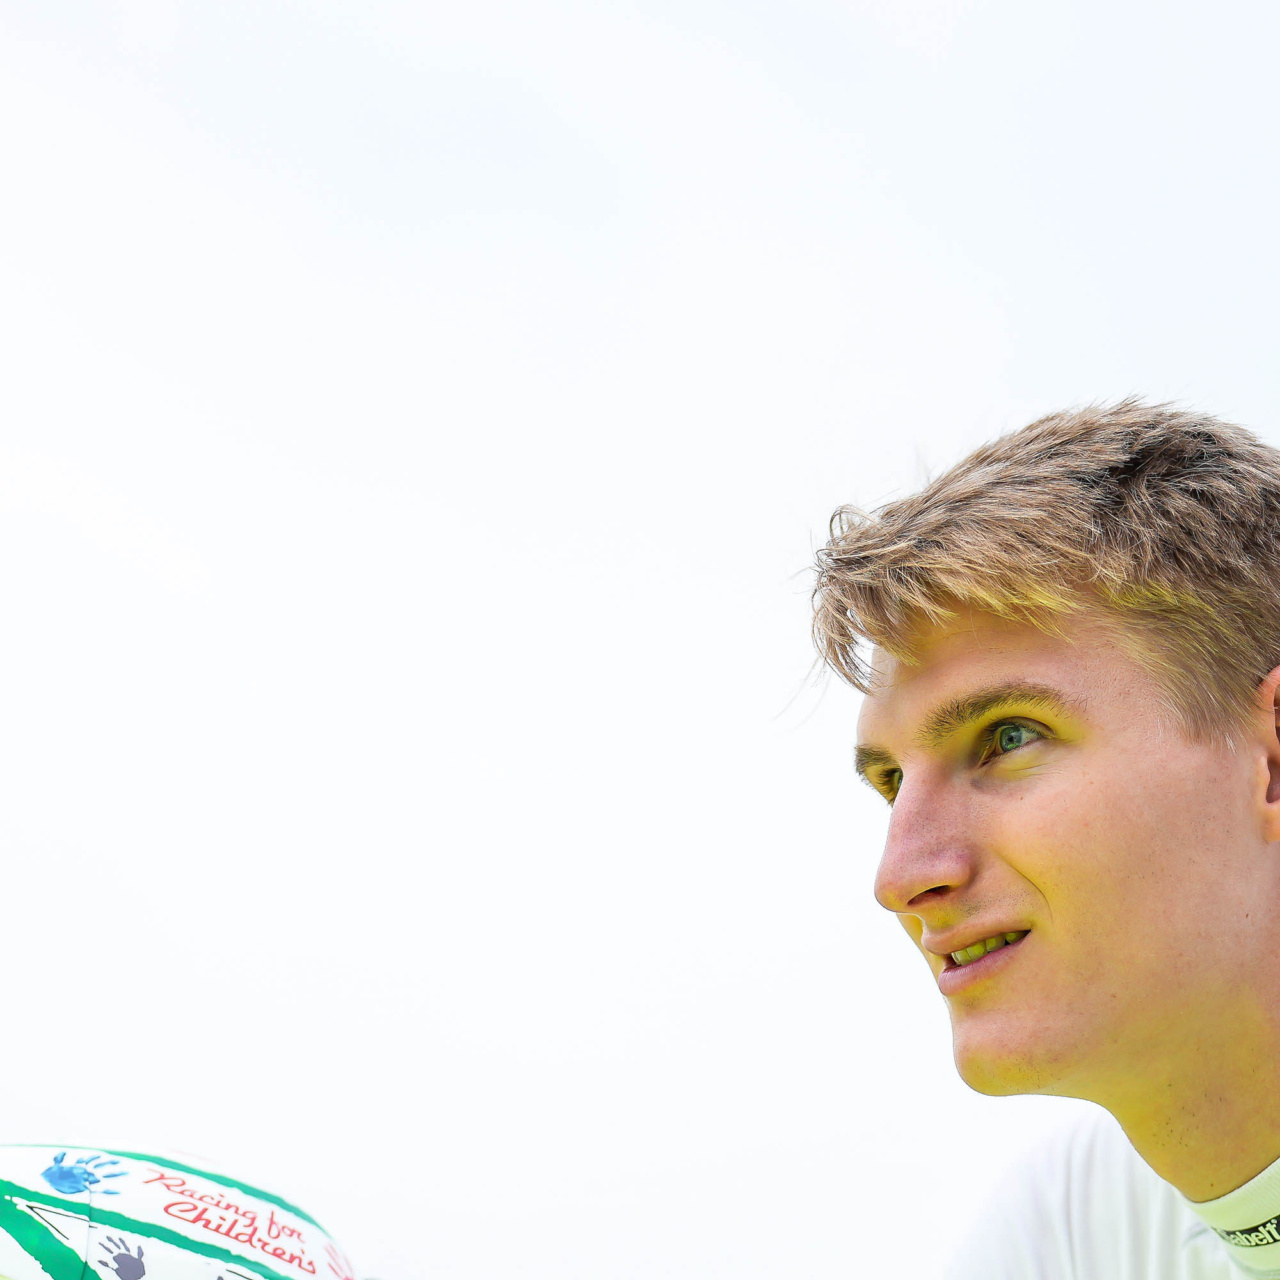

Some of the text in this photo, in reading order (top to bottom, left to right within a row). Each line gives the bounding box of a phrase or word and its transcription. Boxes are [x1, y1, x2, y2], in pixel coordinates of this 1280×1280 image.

[142, 1166, 306, 1243] Racing for
[163, 1201, 317, 1275] Children's
